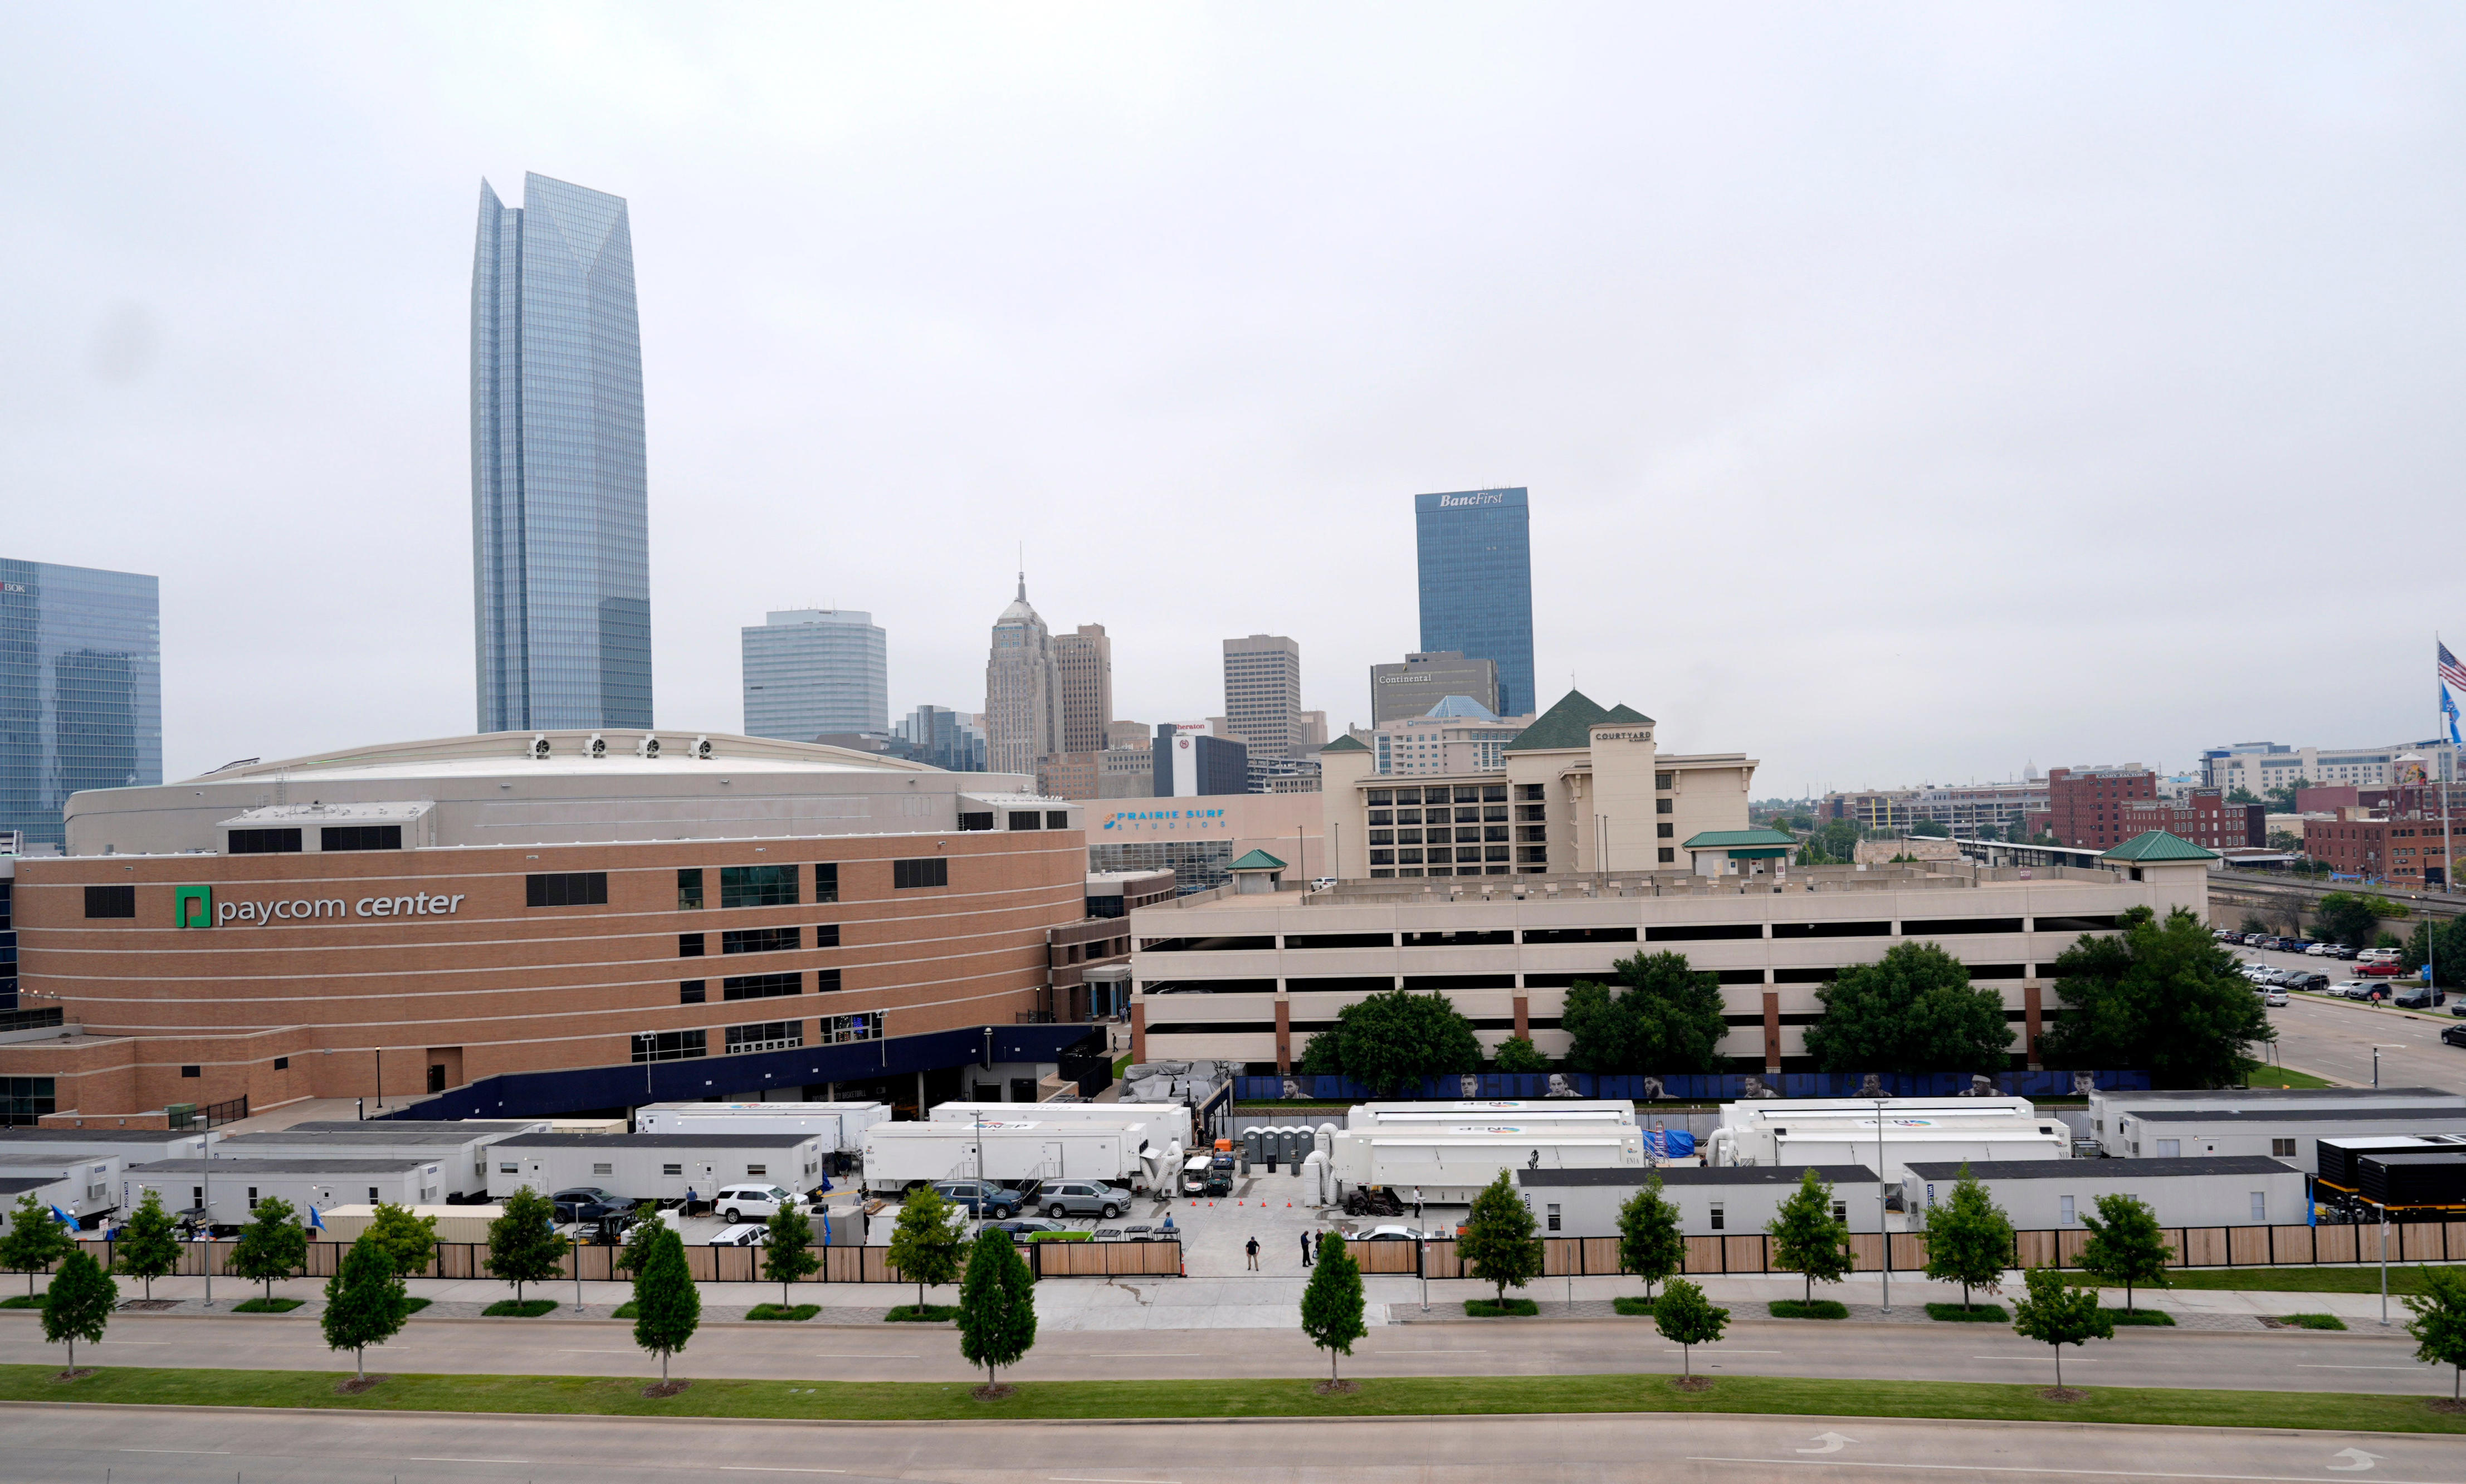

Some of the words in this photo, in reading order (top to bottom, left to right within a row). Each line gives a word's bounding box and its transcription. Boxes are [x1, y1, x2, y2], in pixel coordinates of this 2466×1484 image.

[1440, 492, 1502, 507] BancFirst
[4, 583, 26, 593] BOK
[1379, 674, 1431, 684] Continental
[1596, 731, 1650, 740] COURTYARD
[1117, 811, 1179, 821] PRAIRIE
[1186, 809, 1225, 818] SURF
[1117, 821, 1225, 831] STUDIOS
[218, 899, 345, 926] paycom
[355, 892, 465, 916] center
[842, 1090, 866, 1099] BASKETBALL
